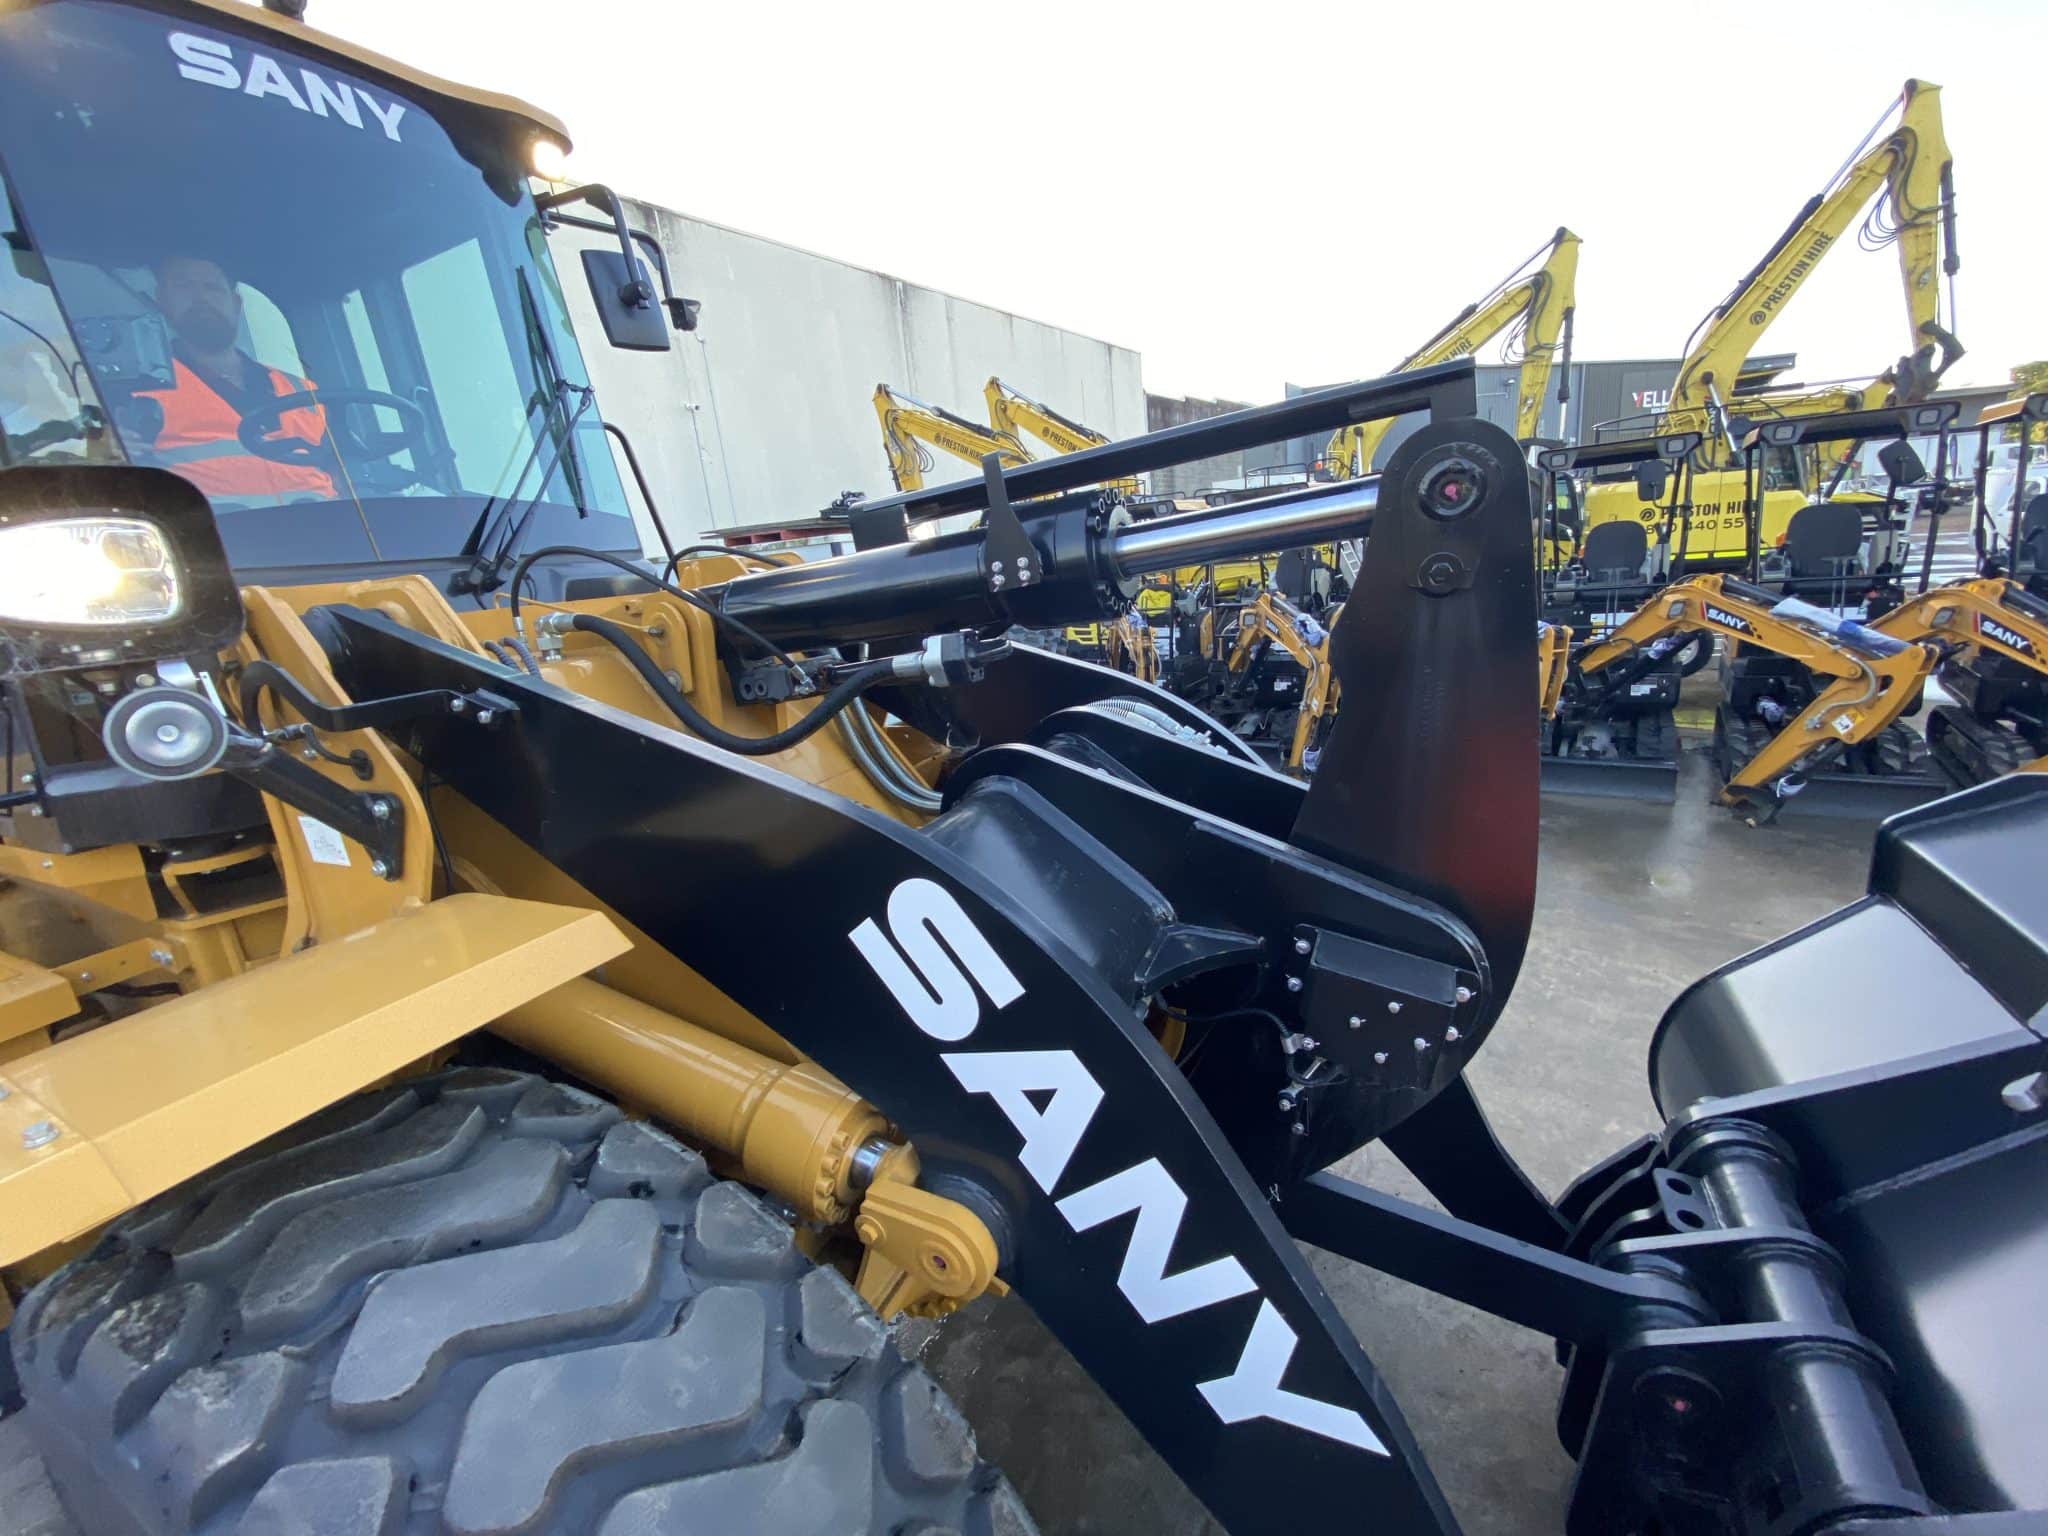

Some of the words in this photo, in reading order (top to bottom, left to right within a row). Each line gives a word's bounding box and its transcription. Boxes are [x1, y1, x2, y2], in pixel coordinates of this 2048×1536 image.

[169, 32, 406, 142] SANY
[1761, 259, 1811, 312] PRESTON
[1803, 231, 1834, 261] HIRE
[1723, 516, 1745, 529] 55
[1707, 608, 1746, 629] SANY
[1981, 621, 2029, 649] SANY
[848, 878, 1391, 1456] SANY
